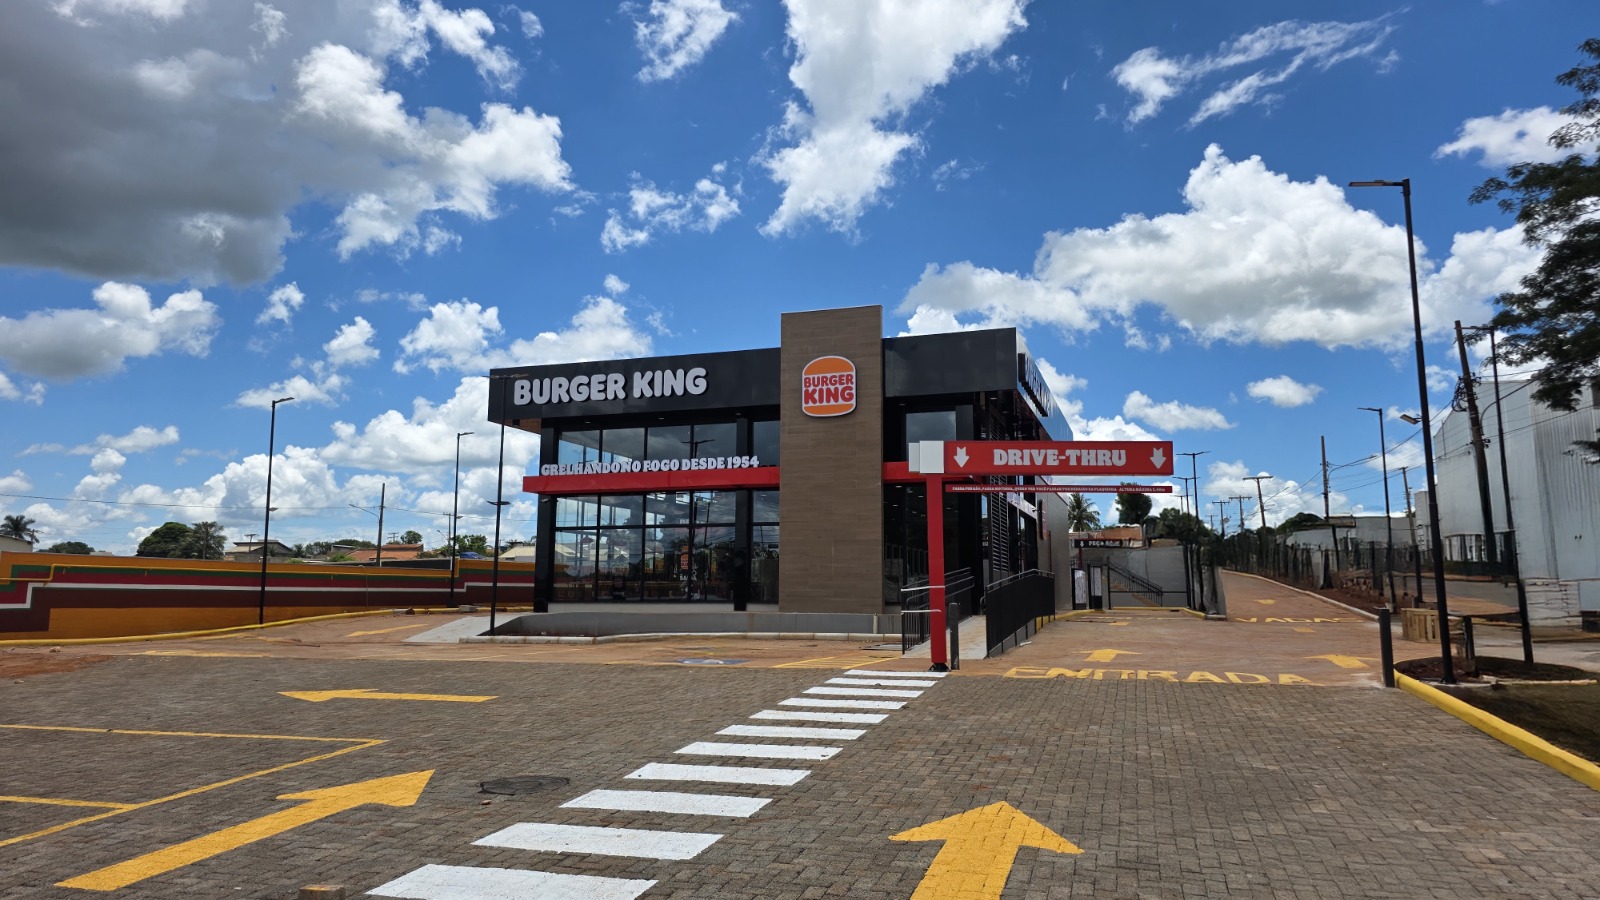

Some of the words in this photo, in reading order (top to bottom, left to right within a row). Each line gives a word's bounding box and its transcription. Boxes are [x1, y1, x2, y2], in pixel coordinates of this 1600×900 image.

[514, 373, 626, 406] BURGER
[633, 367, 707, 398] KING
[803, 373, 854, 388] BURGER
[803, 386, 854, 405] KING
[541, 461, 620, 476] GRELHANDO
[621, 460, 641, 473] NO
[642, 460, 679, 473] FOGO
[681, 457, 725, 470] DESDE
[726, 455, 760, 469] 1954
[993, 449, 1127, 467] DRIVE-THRU
[1003, 666, 1326, 686] ENTRADA
